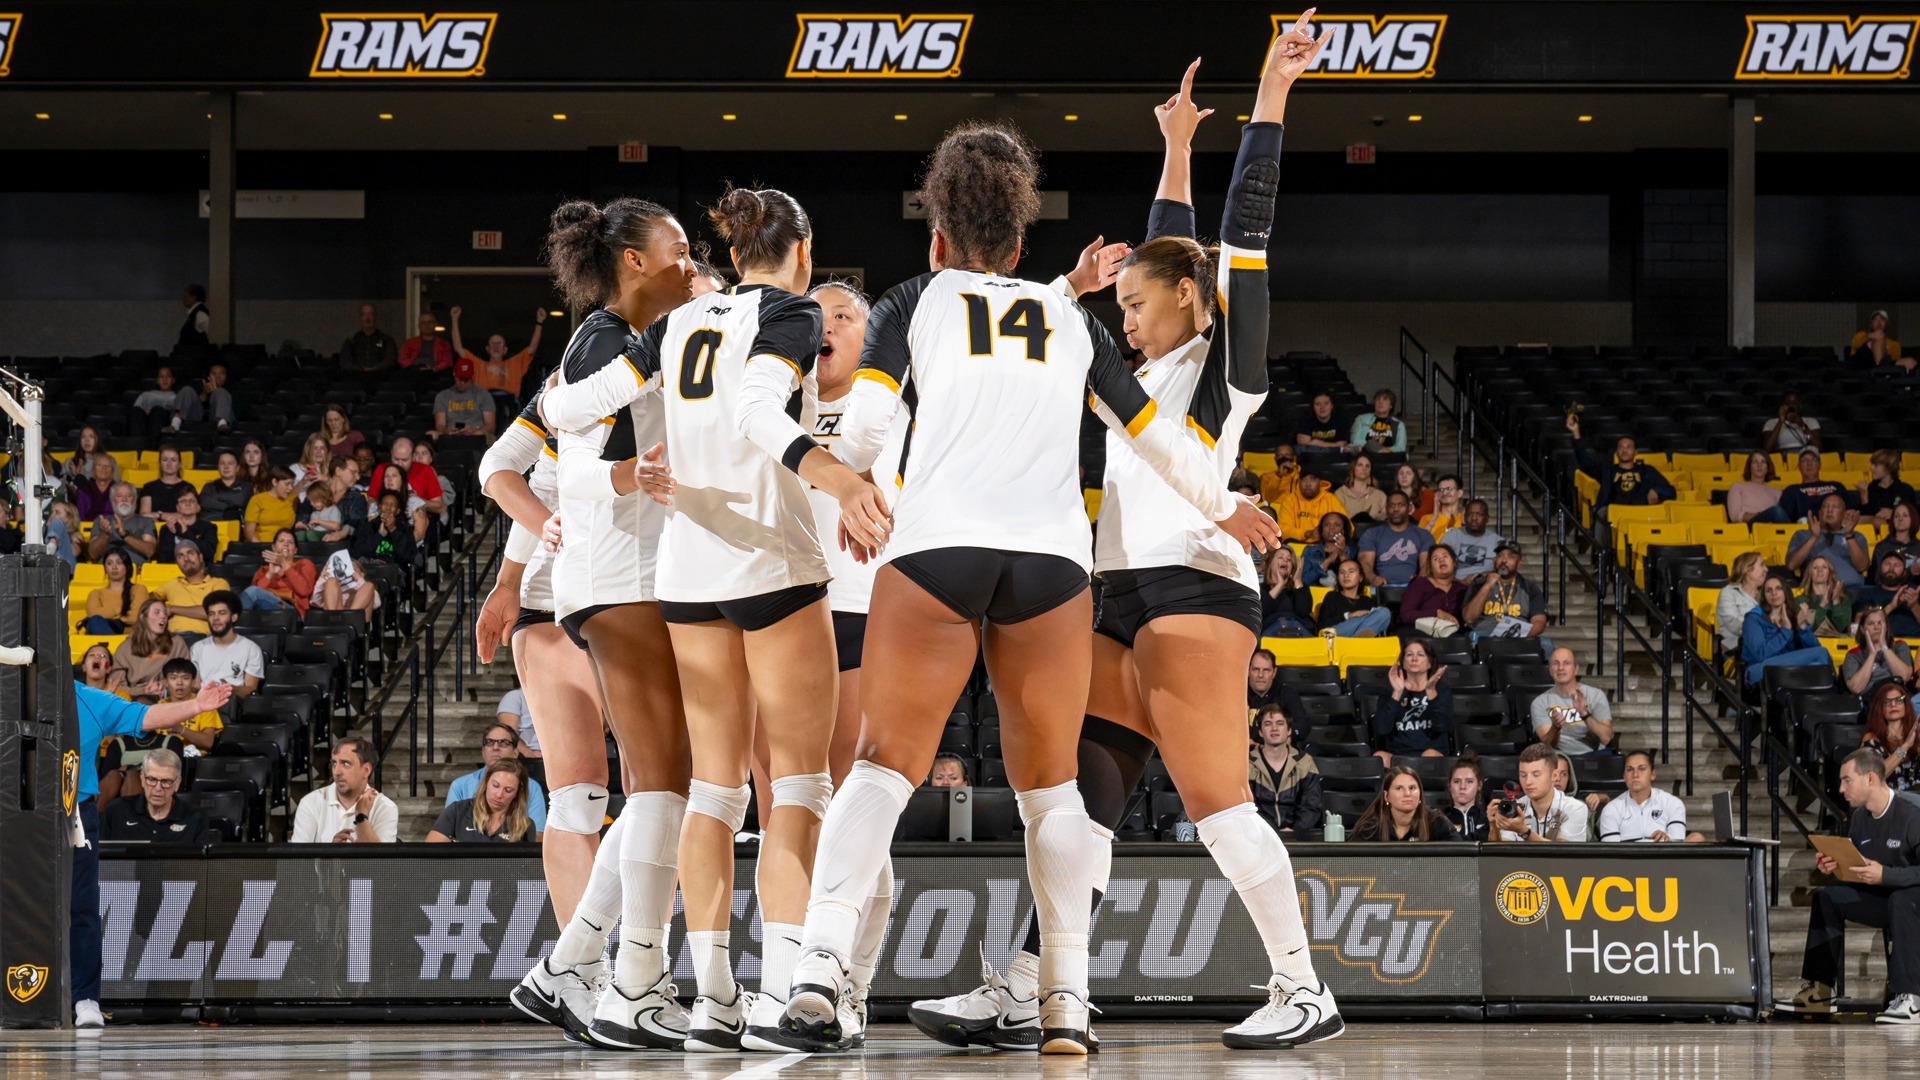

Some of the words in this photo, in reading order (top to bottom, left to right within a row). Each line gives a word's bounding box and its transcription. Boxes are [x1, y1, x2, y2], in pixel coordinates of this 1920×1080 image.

[319, 20, 487, 69] RAMS
[795, 21, 963, 70] RAMS
[1745, 22, 1911, 72] RAMS
[623, 144, 643, 160] EXIT
[478, 232, 497, 247] EXIT
[957, 291, 1055, 365] 14
[678, 327, 725, 401] 0
[1549, 876, 1679, 923] VCU
[1301, 878, 1433, 974] VCU
[1565, 928, 1720, 976] Health
[1134, 994, 1194, 1002] DAKTRONICS
